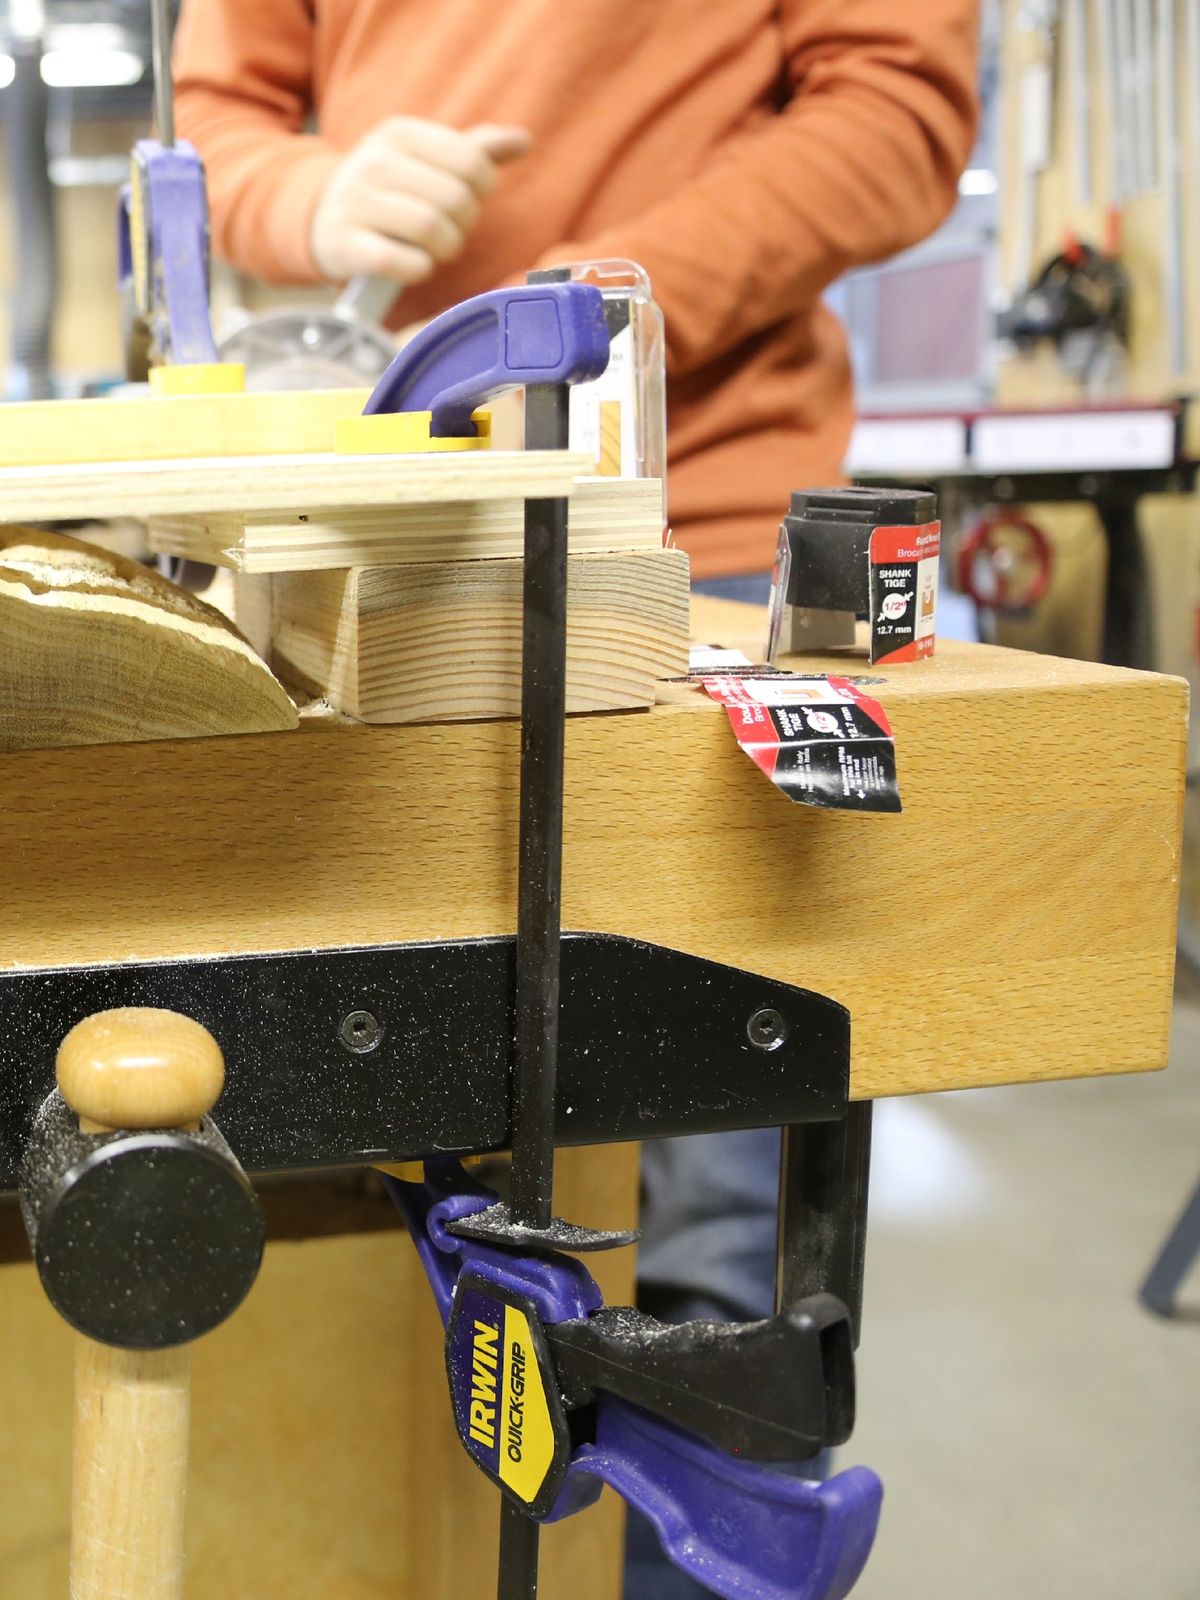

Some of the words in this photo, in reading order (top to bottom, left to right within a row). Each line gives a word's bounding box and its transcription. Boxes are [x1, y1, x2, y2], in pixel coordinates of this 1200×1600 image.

[879, 569, 912, 578] SHANK
[884, 579, 906, 588] TIGE
[884, 601, 907, 611] 1/2"
[877, 626, 893, 634] 12.7
[895, 626, 912, 634] mm
[841, 706, 853, 721] mm
[775, 708, 795, 737] SHANK
[788, 713, 804, 732] TIGE
[845, 722, 859, 738] 12.7
[469, 1320, 499, 1449] IRWIN
[508, 1342, 526, 1463] QUICK-GRIP
